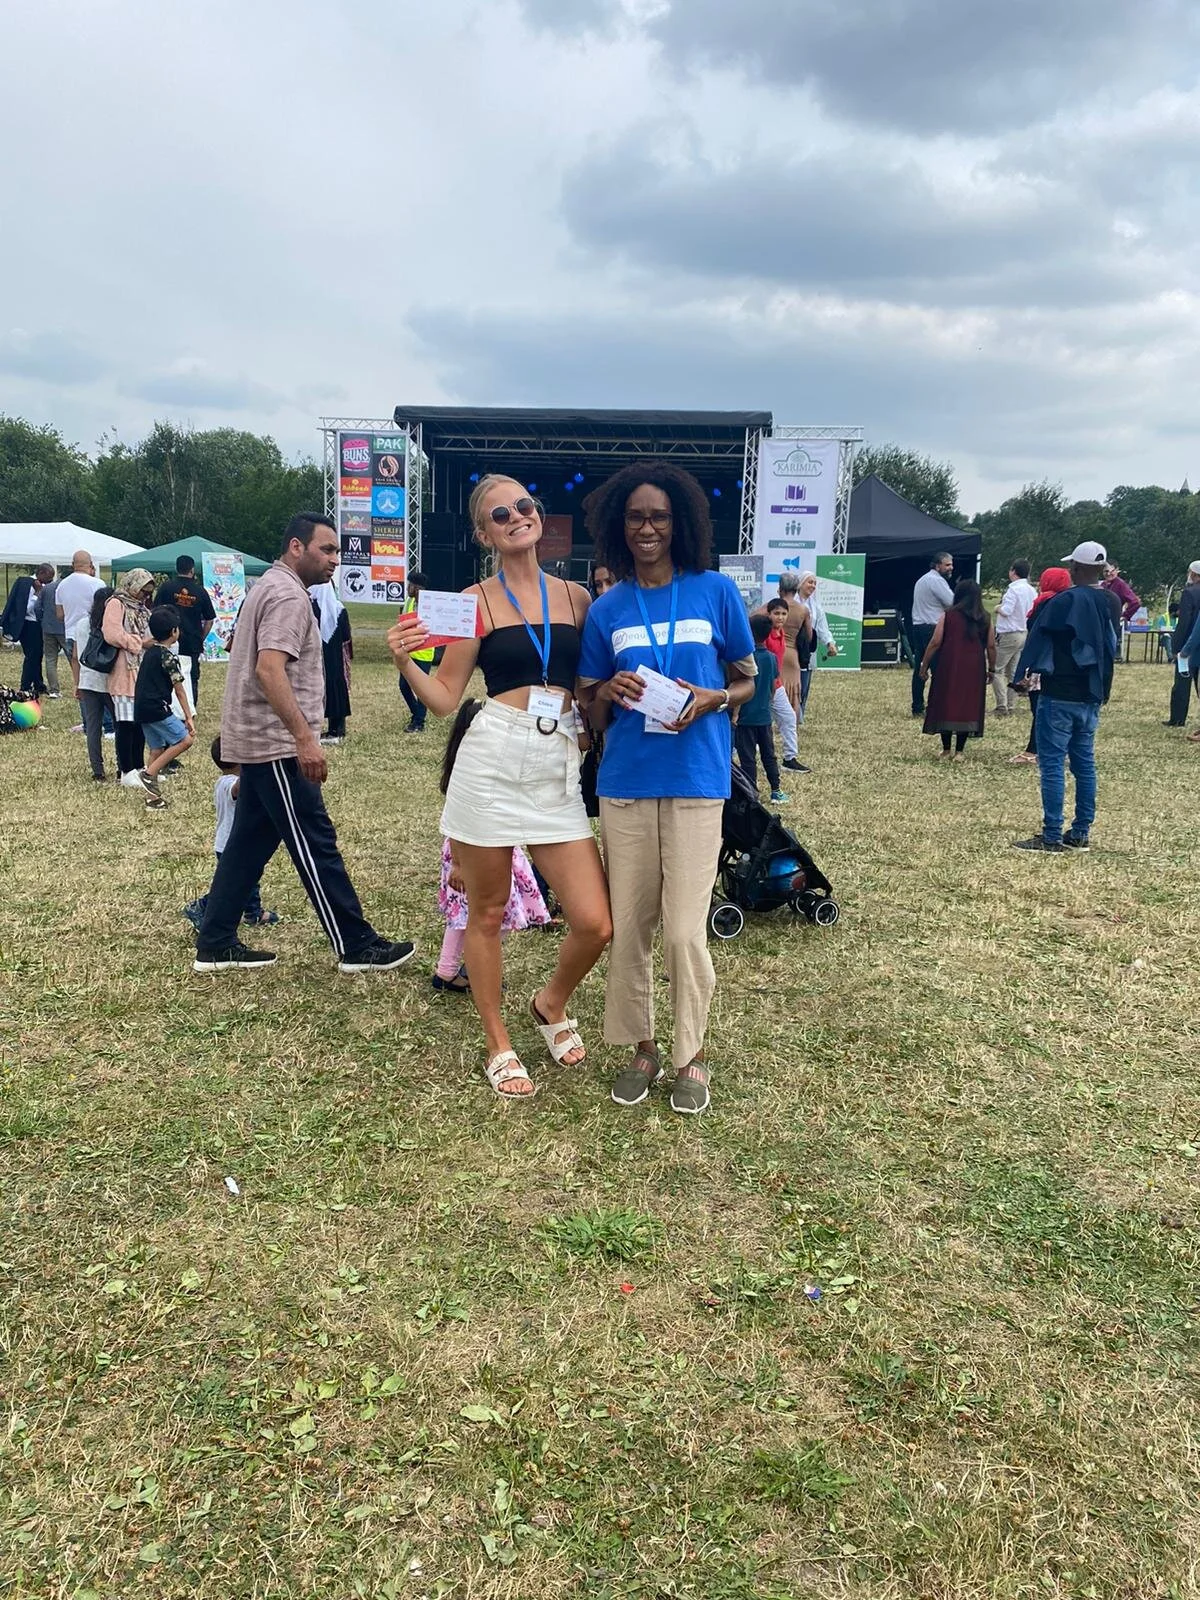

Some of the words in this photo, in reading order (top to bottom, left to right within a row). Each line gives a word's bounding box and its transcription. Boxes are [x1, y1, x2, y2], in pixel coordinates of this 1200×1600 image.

[376, 438, 402, 449] PAK
[342, 448, 370, 460] BUNS
[777, 462, 818, 472] KARIMIA
